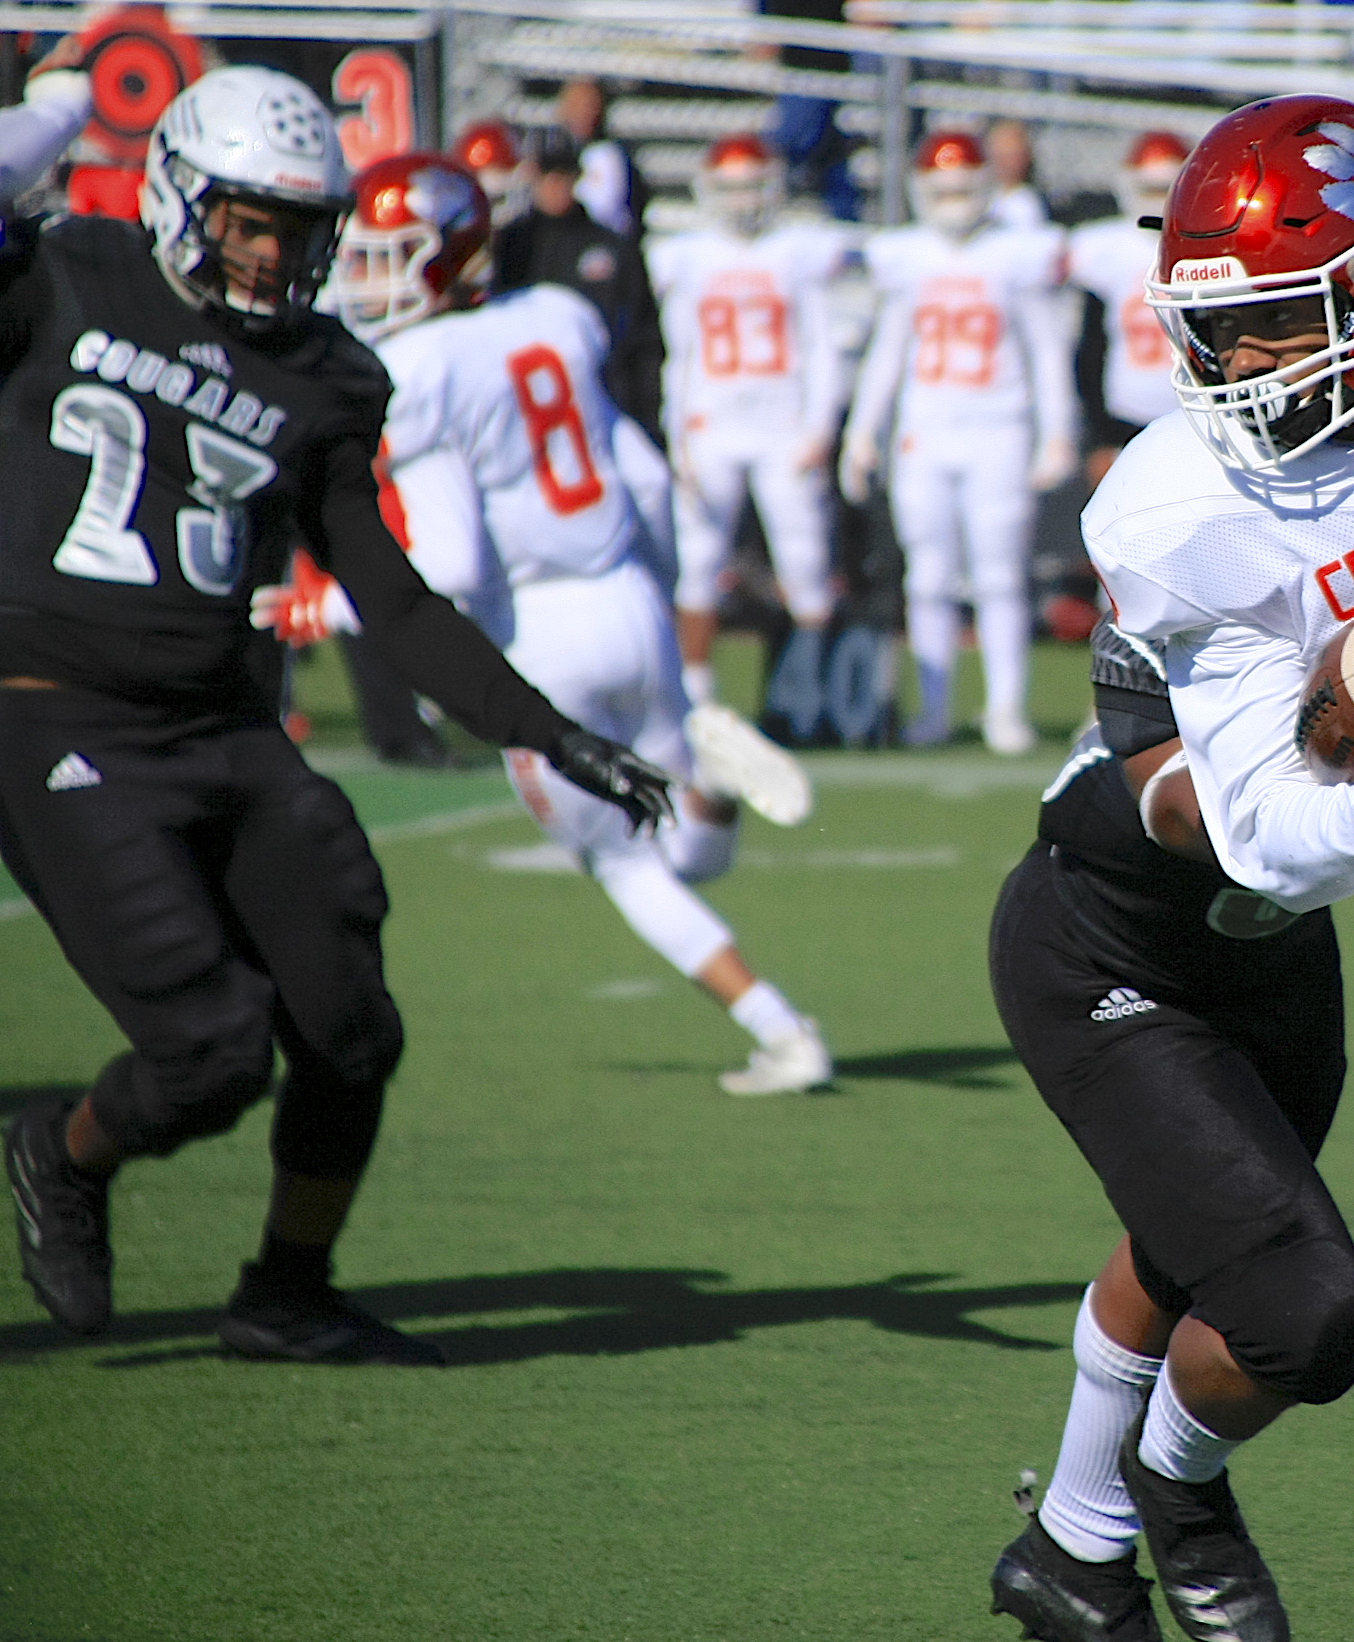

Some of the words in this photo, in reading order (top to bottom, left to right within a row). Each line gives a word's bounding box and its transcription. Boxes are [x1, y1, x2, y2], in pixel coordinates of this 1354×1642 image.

[334, 49, 413, 172] 3
[1175, 262, 1232, 283] Riddell
[70, 329, 288, 447] COUGARS
[696, 294, 788, 378] 83
[506, 342, 605, 518] 8
[49, 382, 280, 596] 23
[767, 626, 897, 739] 40
[1090, 999, 1158, 1022] adidas
